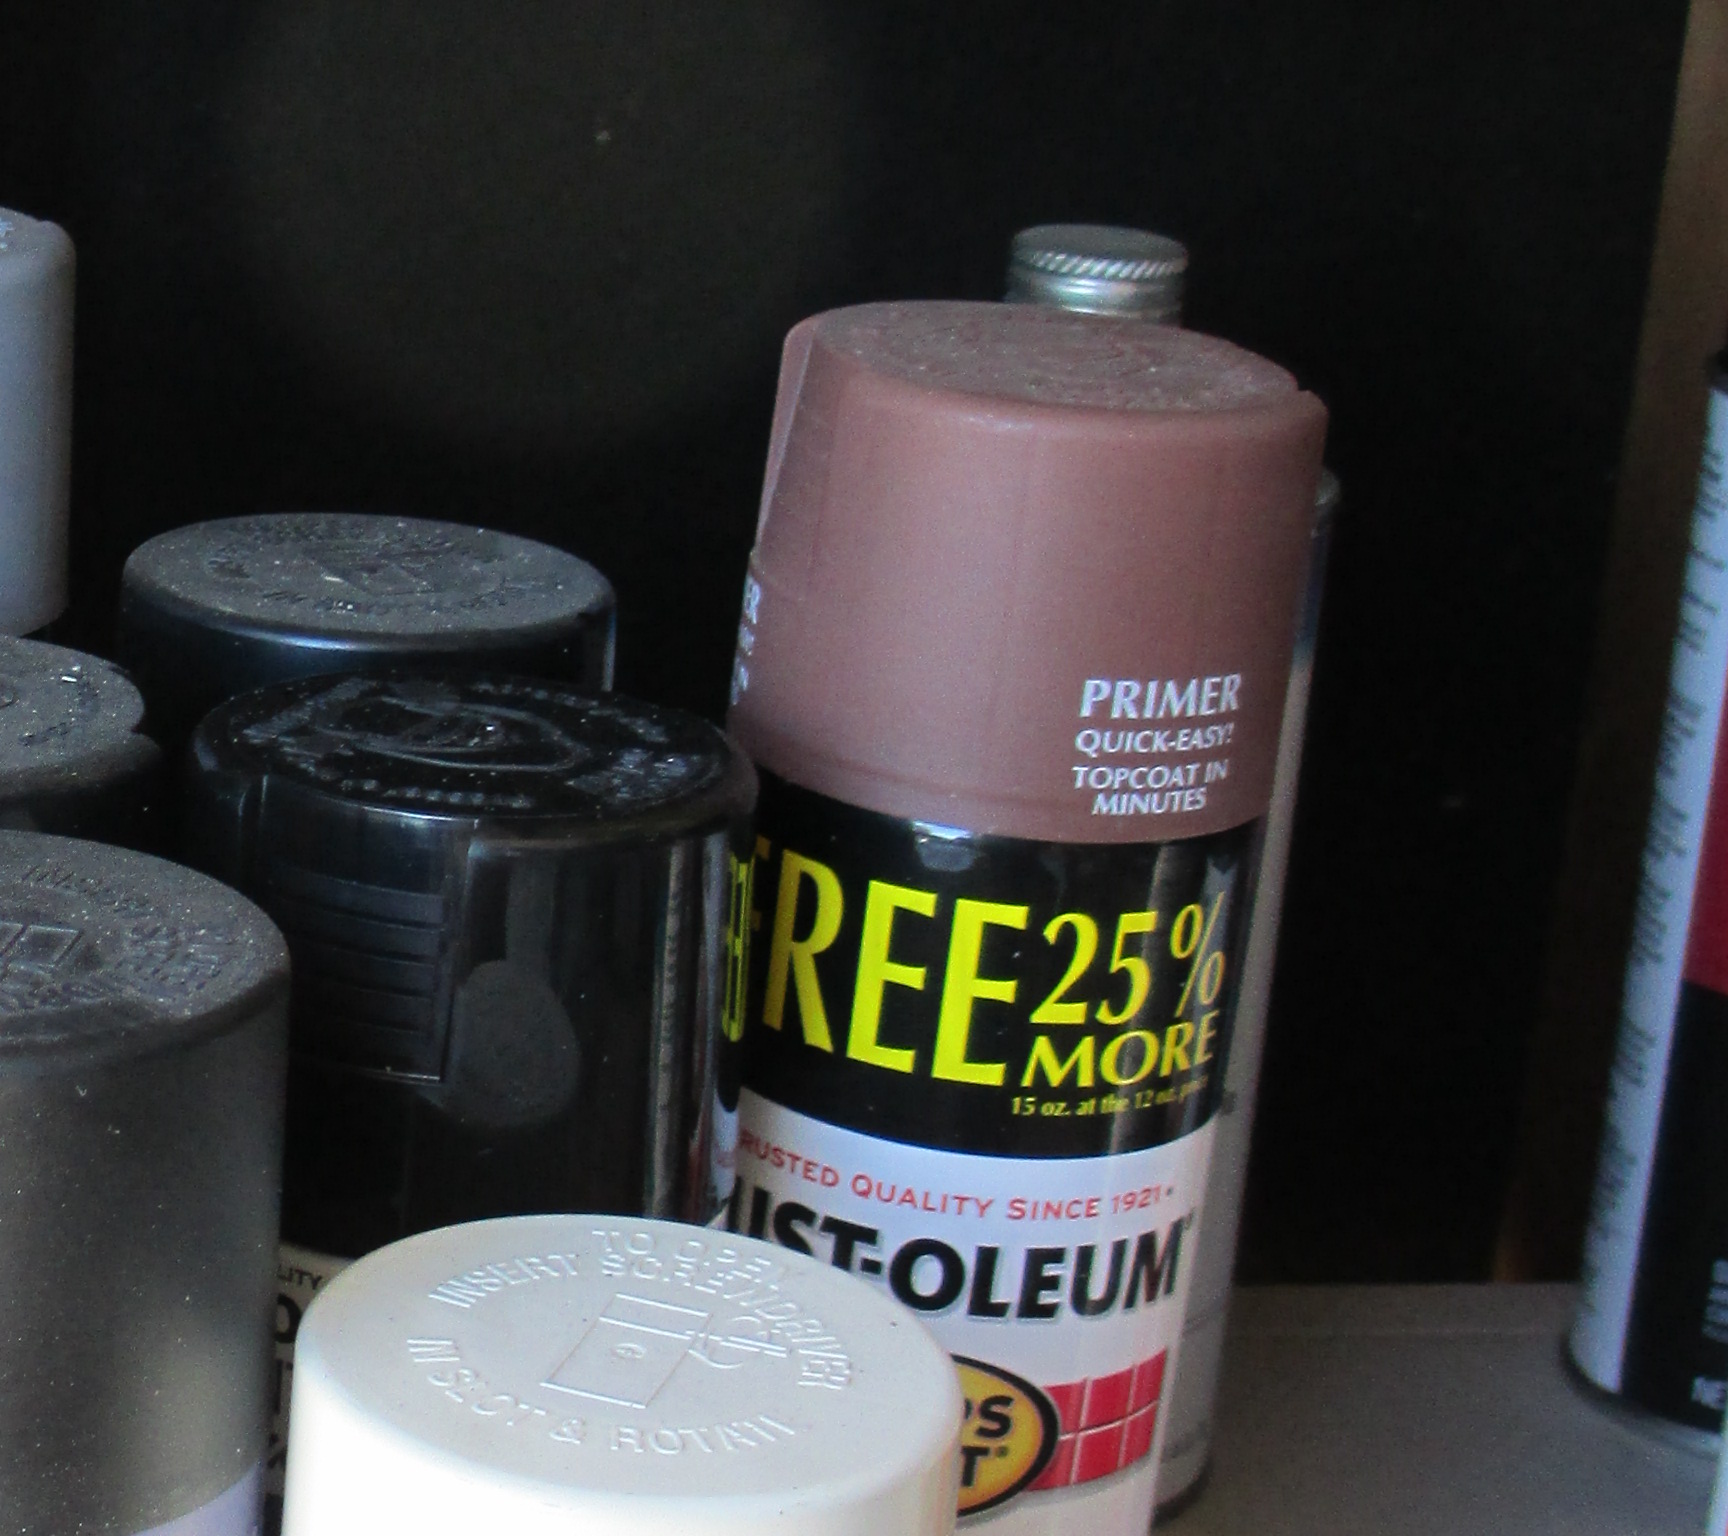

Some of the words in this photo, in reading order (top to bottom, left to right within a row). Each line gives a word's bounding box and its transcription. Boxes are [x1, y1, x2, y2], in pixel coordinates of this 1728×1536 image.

[1078, 672, 1242, 720] PRIMER
[1075, 722, 1235, 755] QUICK-EASY!
[1072, 763, 1199, 792] TOPCOAT
[1204, 759, 1229, 783] IN
[1092, 786, 1208, 817] MINUTES
[1020, 1009, 1217, 1089] MORE
[1012, 1096, 1037, 1116] 15
[1075, 1097, 1097, 1116] at
[736, 1128, 840, 1189] RUSTED
[851, 1172, 994, 1220] QUALITY
[1006, 1195, 1100, 1223] SINCE
[591, 1228, 656, 1257] TO
[726, 1176, 1189, 1321] UST-OLEUM
[428, 1253, 581, 1310] INSERT
